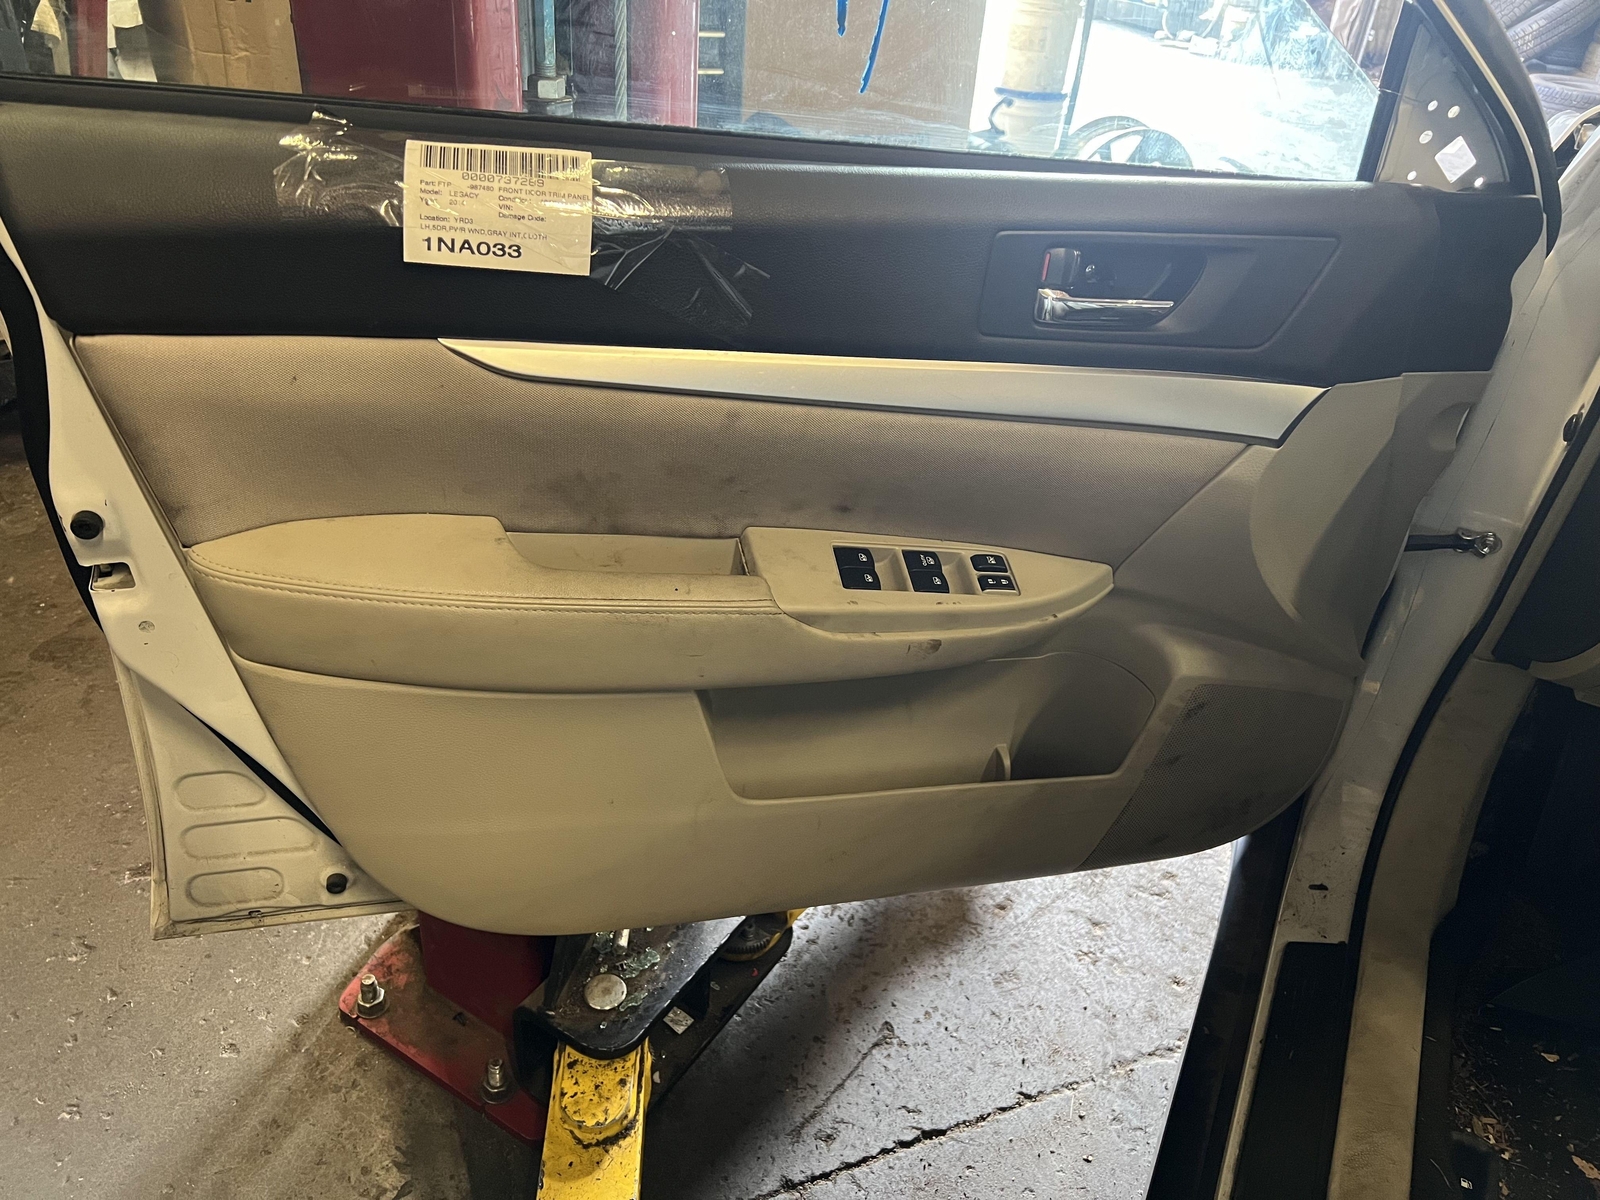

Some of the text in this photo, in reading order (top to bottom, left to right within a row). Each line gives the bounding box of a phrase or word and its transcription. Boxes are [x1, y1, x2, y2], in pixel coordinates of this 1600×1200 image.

[567, 193, 590, 201] PANEL
[420, 213, 450, 222] Location:
[498, 212, 525, 220] Damage
[422, 236, 522, 259] 1NA033
